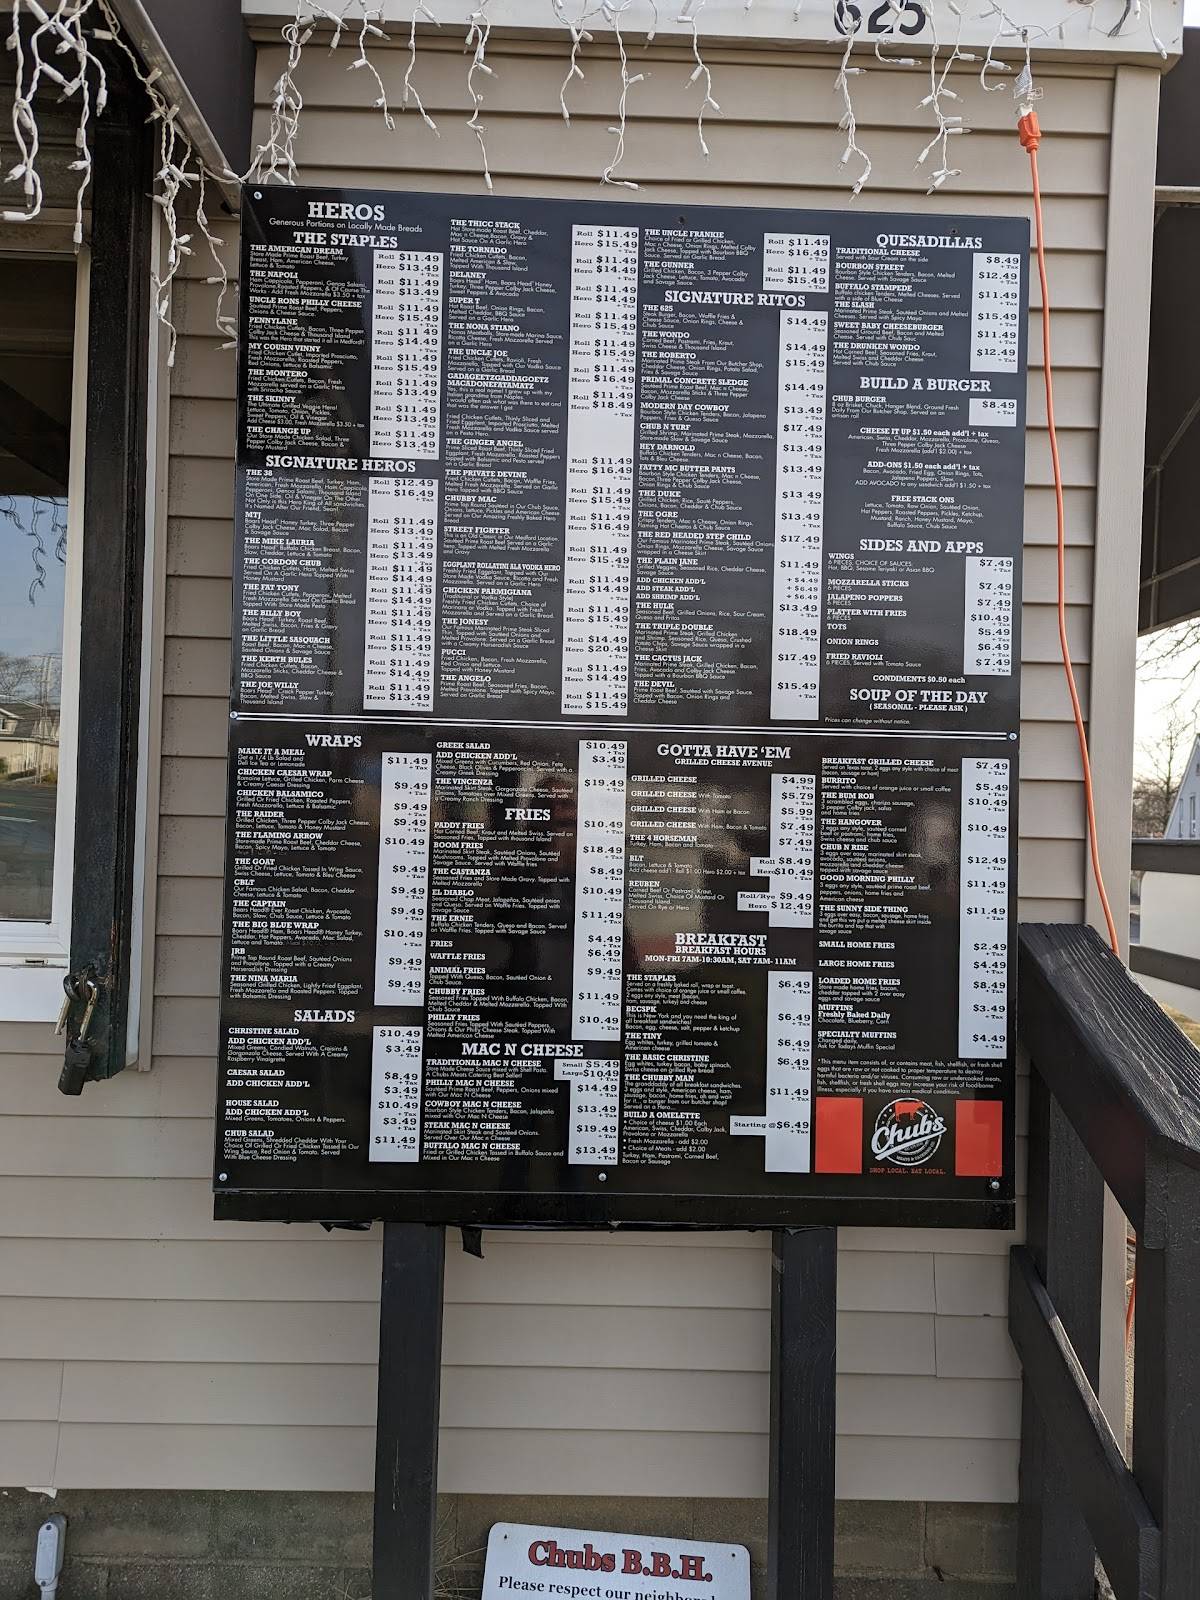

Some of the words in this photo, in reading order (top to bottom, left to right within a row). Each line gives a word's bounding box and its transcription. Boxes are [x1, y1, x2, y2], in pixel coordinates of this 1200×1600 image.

[834, 0, 926, 36] 625
[308, 202, 385, 221] HEROS
[269, 218, 304, 226] Generous
[306, 220, 335, 228] Portions
[348, 222, 372, 231] Locally
[398, 224, 423, 232] Breads
[293, 231, 326, 245] THE
[331, 234, 398, 248] STAPLES
[597, 240, 638, 248] $15.49
[876, 234, 983, 249] QUESADILLAS
[313, 247, 343, 255] DREAM
[399, 253, 439, 262] $11.49
[986, 256, 1019, 264] $8.49
[664, 290, 754, 305] SIGNATURE
[757, 294, 806, 307] RITOS
[786, 318, 827, 326] $14.49
[860, 377, 909, 390] BUILD
[912, 378, 923, 390] A
[927, 379, 992, 392] BURGER
[266, 456, 358, 471] SIGNATURE
[361, 459, 416, 472] HEROS
[394, 479, 434, 487] $12.49
[860, 539, 903, 551] SIDES
[907, 540, 941, 552] AND
[945, 542, 984, 553] APPS
[979, 559, 1012, 567] $7.49
[588, 645, 628, 653] $20.49
[850, 689, 891, 701] SOUP
[895, 690, 918, 701] OF
[920, 691, 952, 702] THE
[956, 692, 988, 703] DAY
[305, 734, 362, 748] WRAPS
[657, 744, 712, 757] GOTTA
[716, 746, 758, 758] HAVE
[388, 757, 428, 765] $11.49
[584, 779, 624, 787] $19.49
[781, 792, 813, 800] $5.79
[505, 808, 551, 821] FRIES
[967, 856, 1007, 864] $12.49
[780, 892, 812, 900] $9.49
[675, 932, 767, 947] BREAKFAST
[675, 946, 730, 954] BREAKFAST
[734, 947, 766, 955] HOURS
[294, 1010, 355, 1023] SALADS
[462, 1043, 501, 1056] MAC
[504, 1044, 517, 1056] N
[521, 1044, 584, 1057] CHEESE
[586, 1060, 620, 1068] $5.49
[871, 1115, 947, 1156] Chubs
[528, 1540, 616, 1573] Chubs
[621, 1549, 713, 1582] B.B.H.
[498, 1576, 544, 1592] Please
[549, 1583, 602, 1599] respect
[605, 1589, 631, 1598] our
